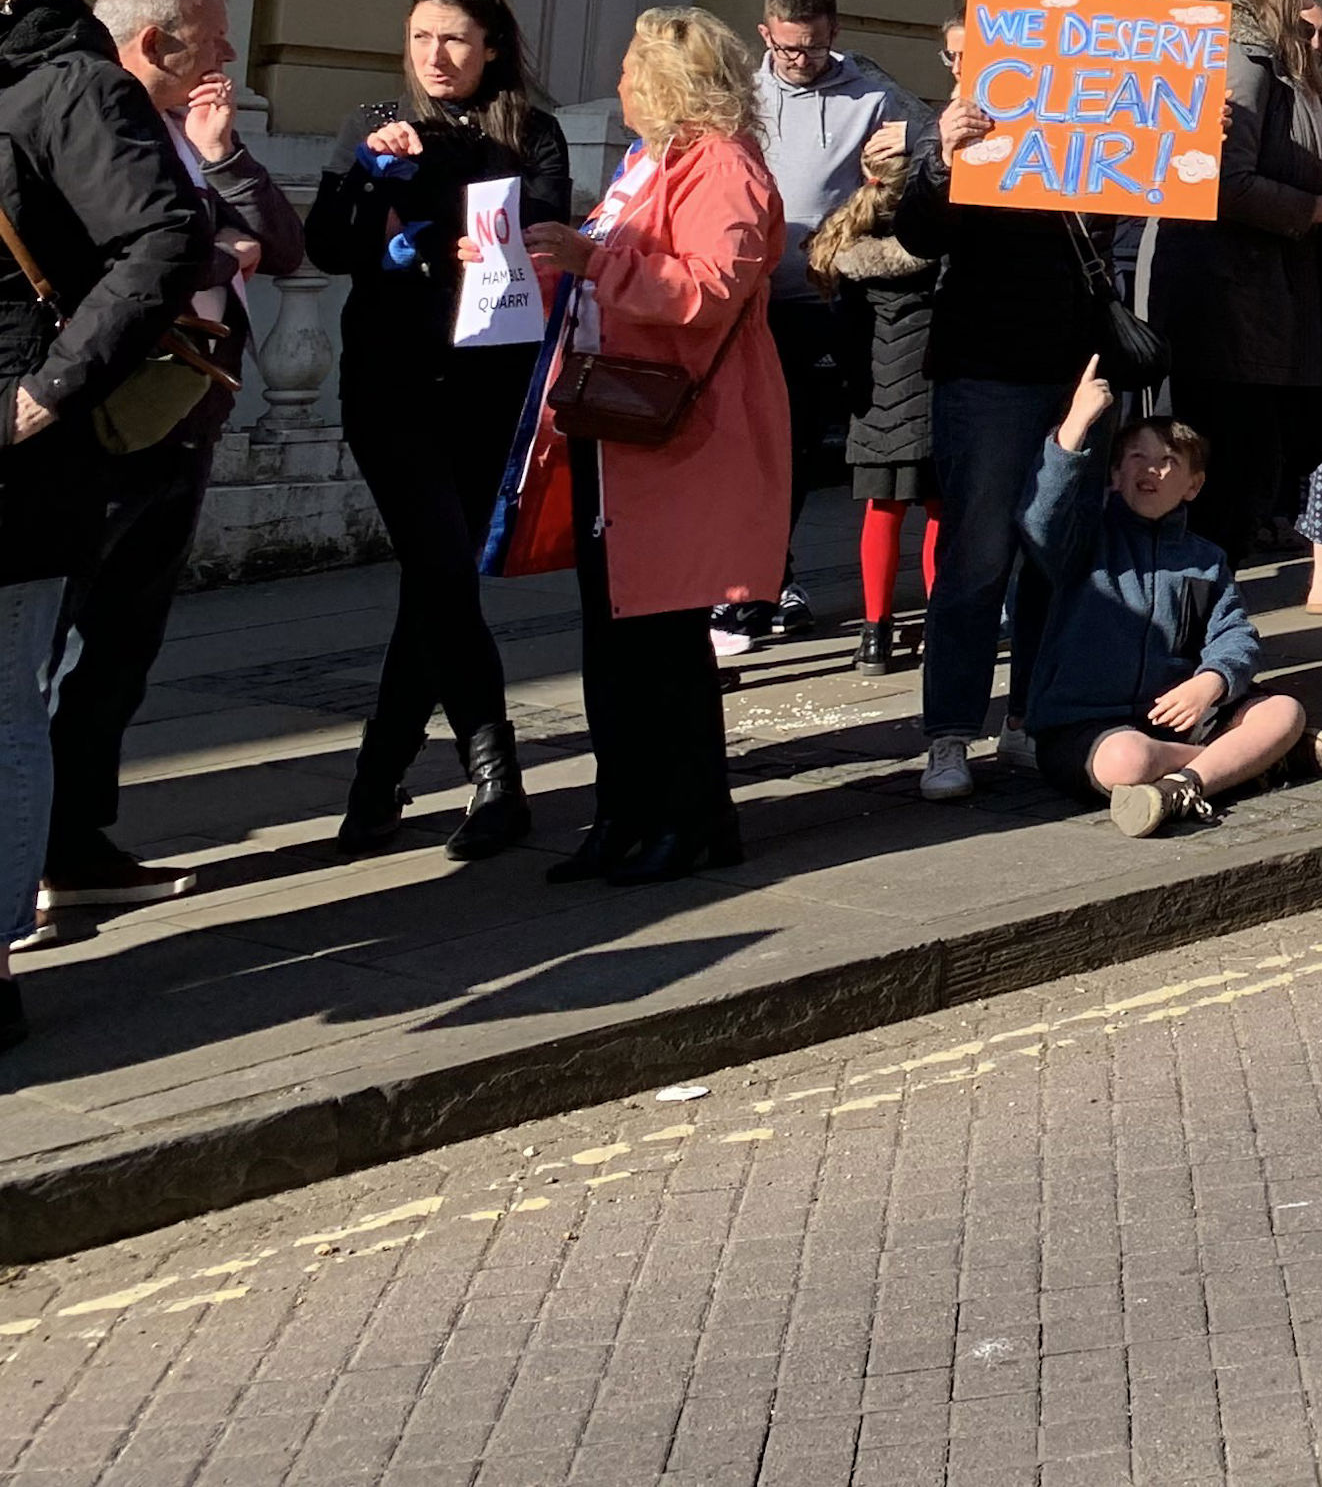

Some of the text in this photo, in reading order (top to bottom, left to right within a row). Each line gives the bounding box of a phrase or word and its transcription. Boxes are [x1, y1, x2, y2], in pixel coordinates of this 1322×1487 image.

[977, 5, 1228, 69] WE DESERVE
[974, 58, 1208, 132] CLEAN
[998, 128, 1175, 205] AIR!
[475, 207, 510, 248] NO
[478, 292, 530, 313] QUARRY
[482, 267, 526, 286] HAMBLE
